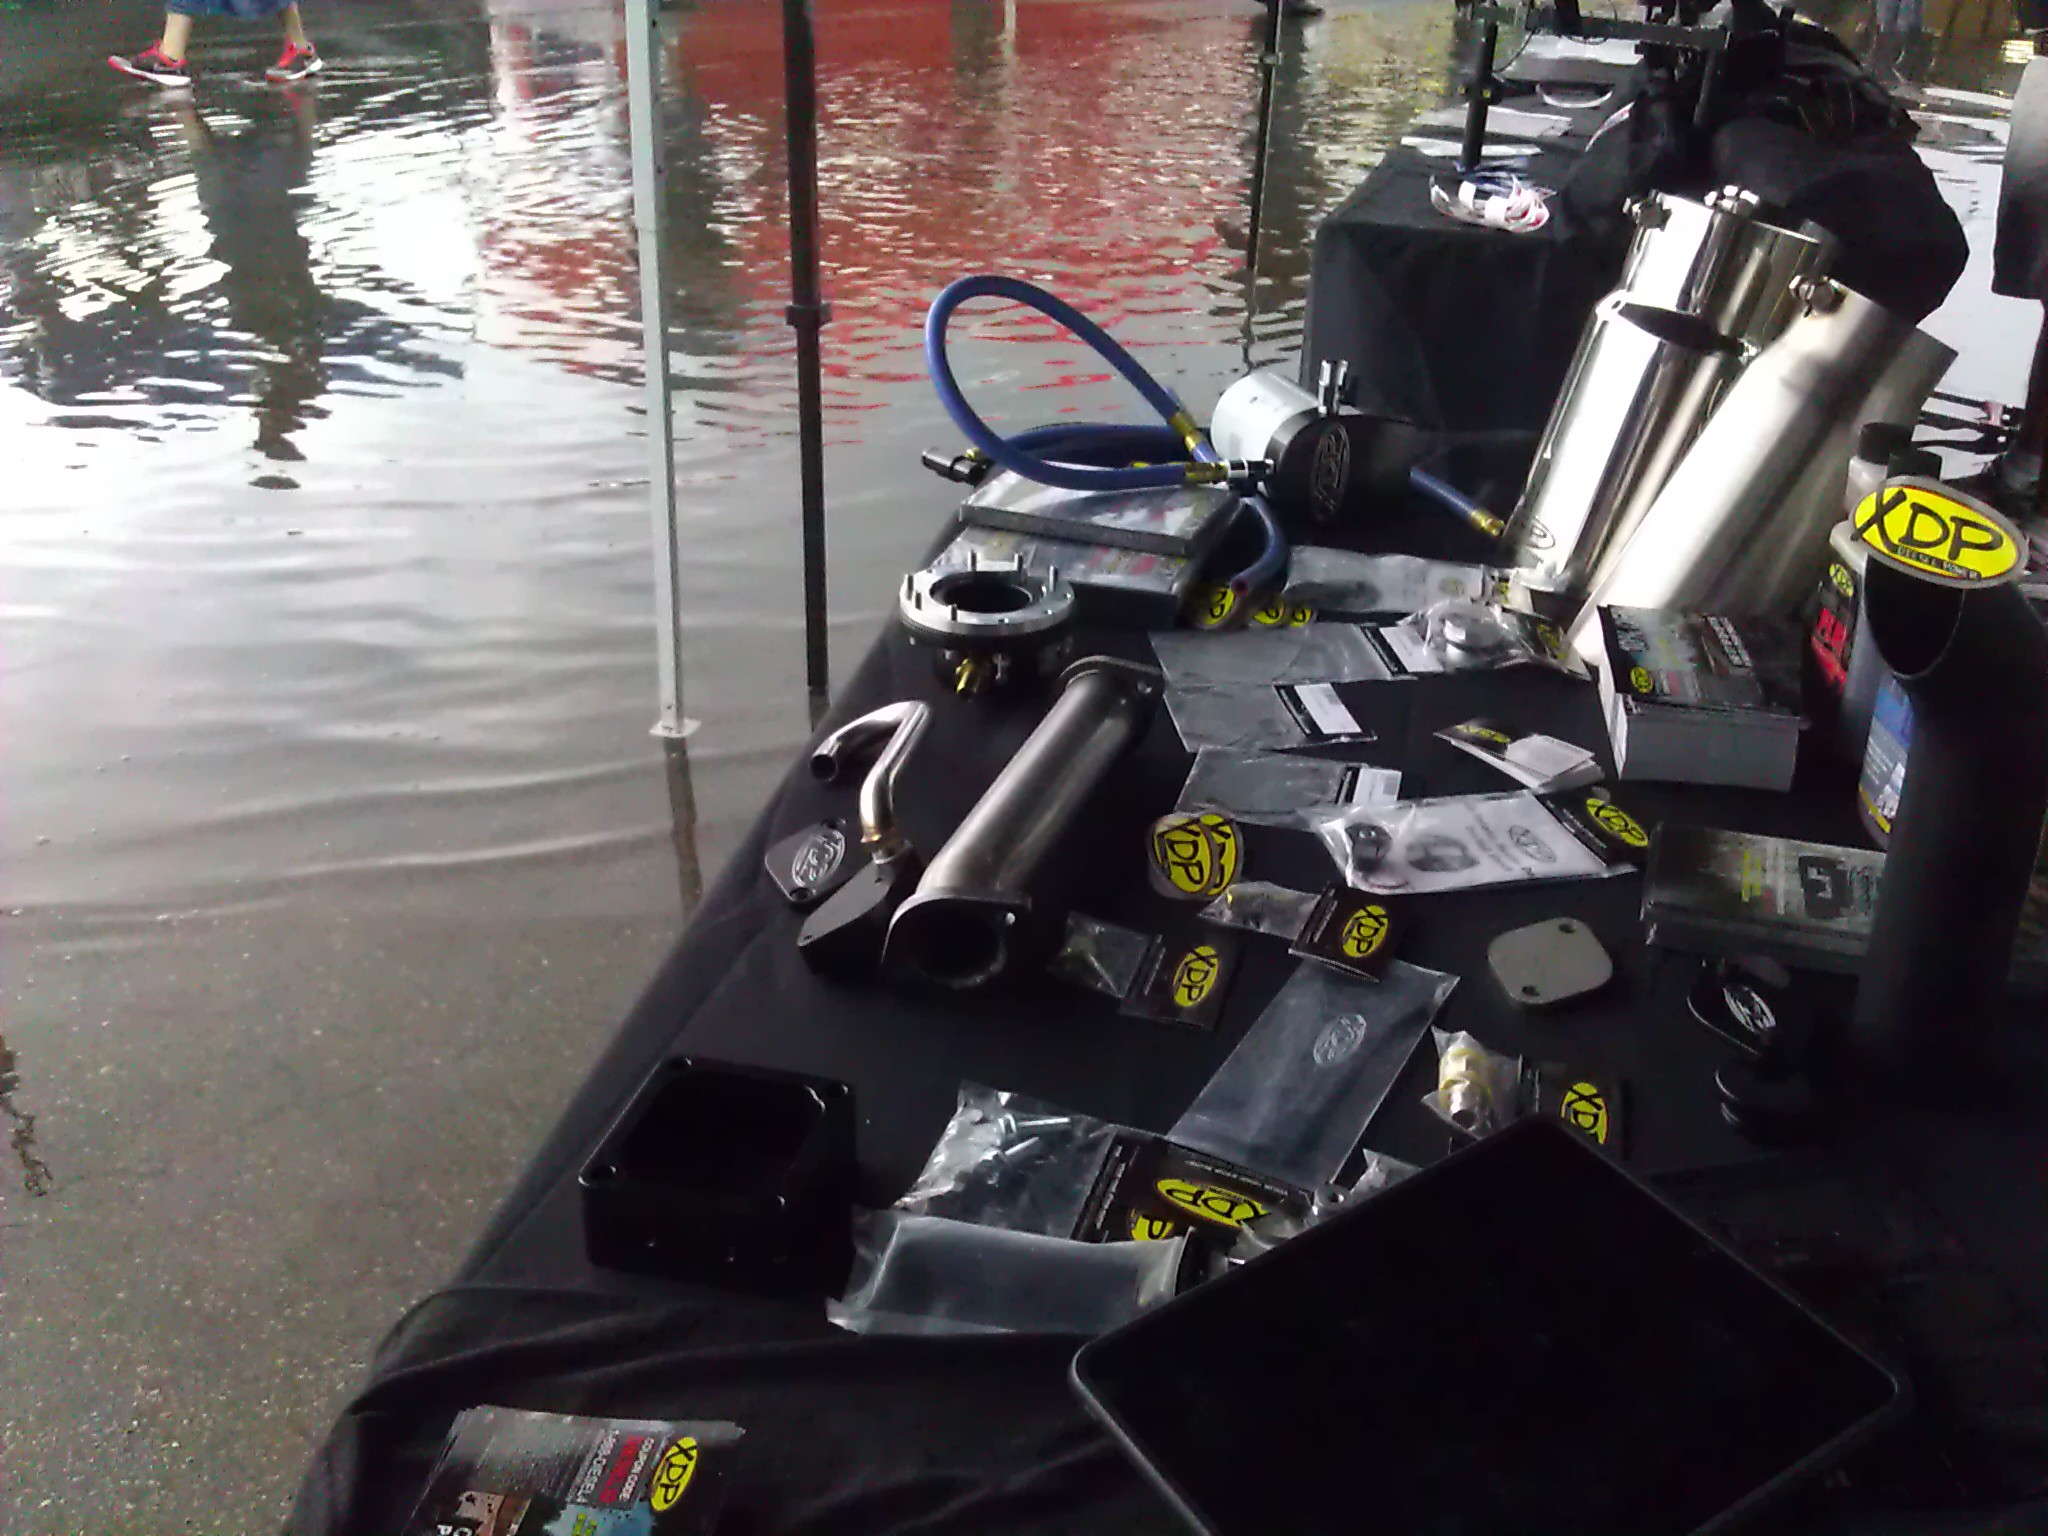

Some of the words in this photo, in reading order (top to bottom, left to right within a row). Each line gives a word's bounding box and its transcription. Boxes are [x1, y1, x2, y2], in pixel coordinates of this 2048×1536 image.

[1851, 489, 2004, 560] XDP
[1158, 819, 1207, 889] XDP
[1345, 905, 1389, 957] XDP
[1176, 946, 1220, 1002] XDP
[1566, 1088, 1603, 1138] XD
[656, 1442, 698, 1505] XDP
